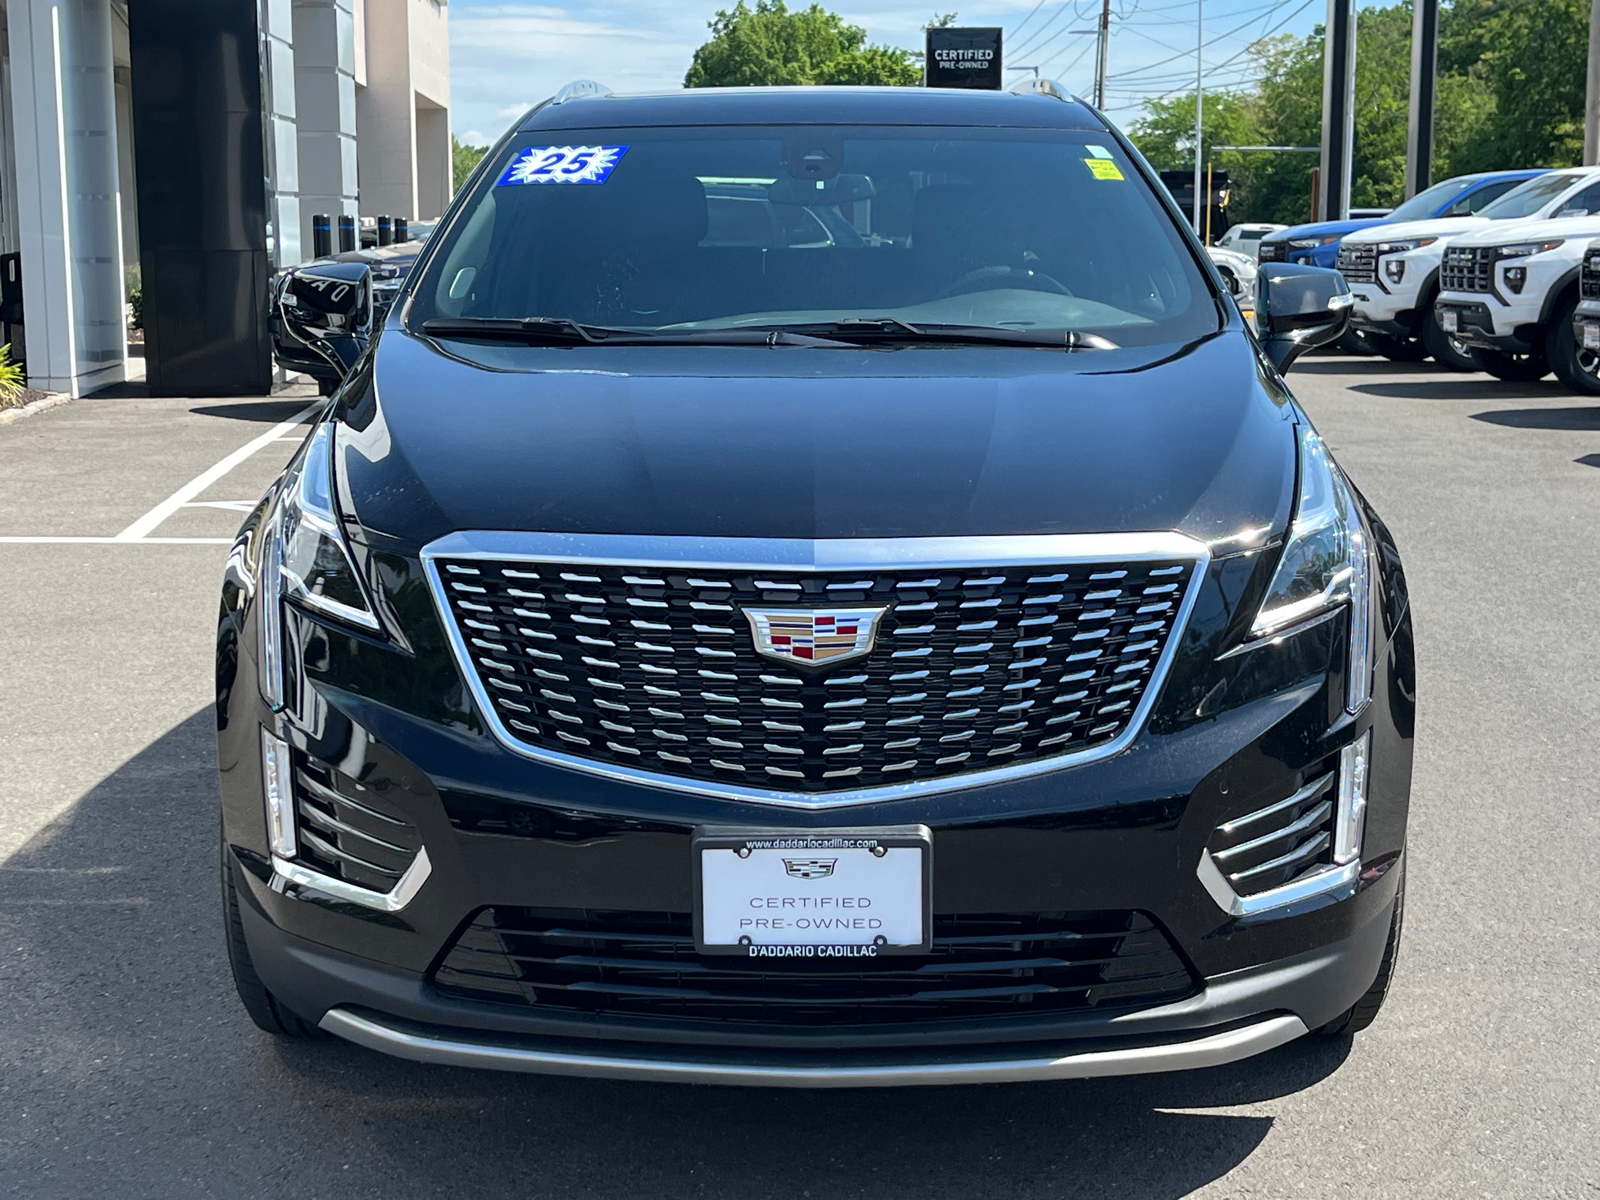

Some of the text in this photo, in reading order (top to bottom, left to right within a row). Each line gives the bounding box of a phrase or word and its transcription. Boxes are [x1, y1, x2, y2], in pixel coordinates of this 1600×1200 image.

[934, 49, 994, 60] CERTIFIED
[939, 61, 989, 69] PRE-OWNED
[528, 152, 598, 175] 25
[746, 838, 878, 849] www.daddariocadillac.com
[749, 897, 872, 909] CERTIFIED
[739, 918, 883, 929] PRE-OWNED
[749, 945, 878, 957] D'ADDARIO CADILLAC
